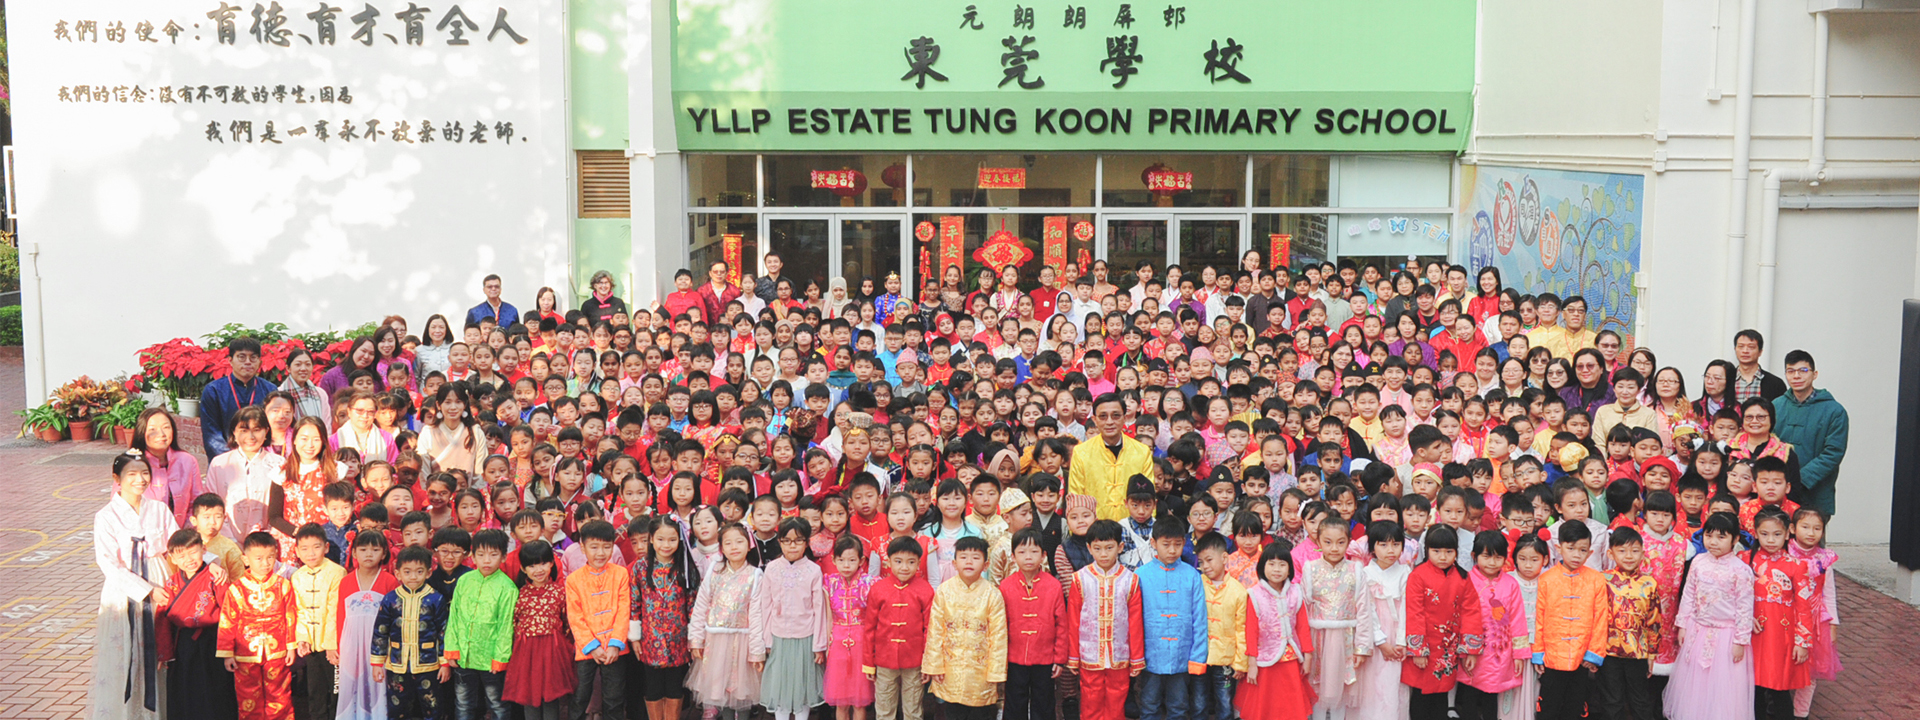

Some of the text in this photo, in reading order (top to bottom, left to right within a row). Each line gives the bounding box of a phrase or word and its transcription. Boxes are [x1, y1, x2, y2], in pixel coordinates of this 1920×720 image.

[959, 4, 1186, 30] 元朗朗屏邨
[900, 34, 1252, 90] 東莞學校
[687, 107, 1456, 135] YLLP ESTATE TUNG KOON PRIMARY SCHOOL
[1411, 218, 1450, 243] STEM
[2, 604, 50, 620] 42
